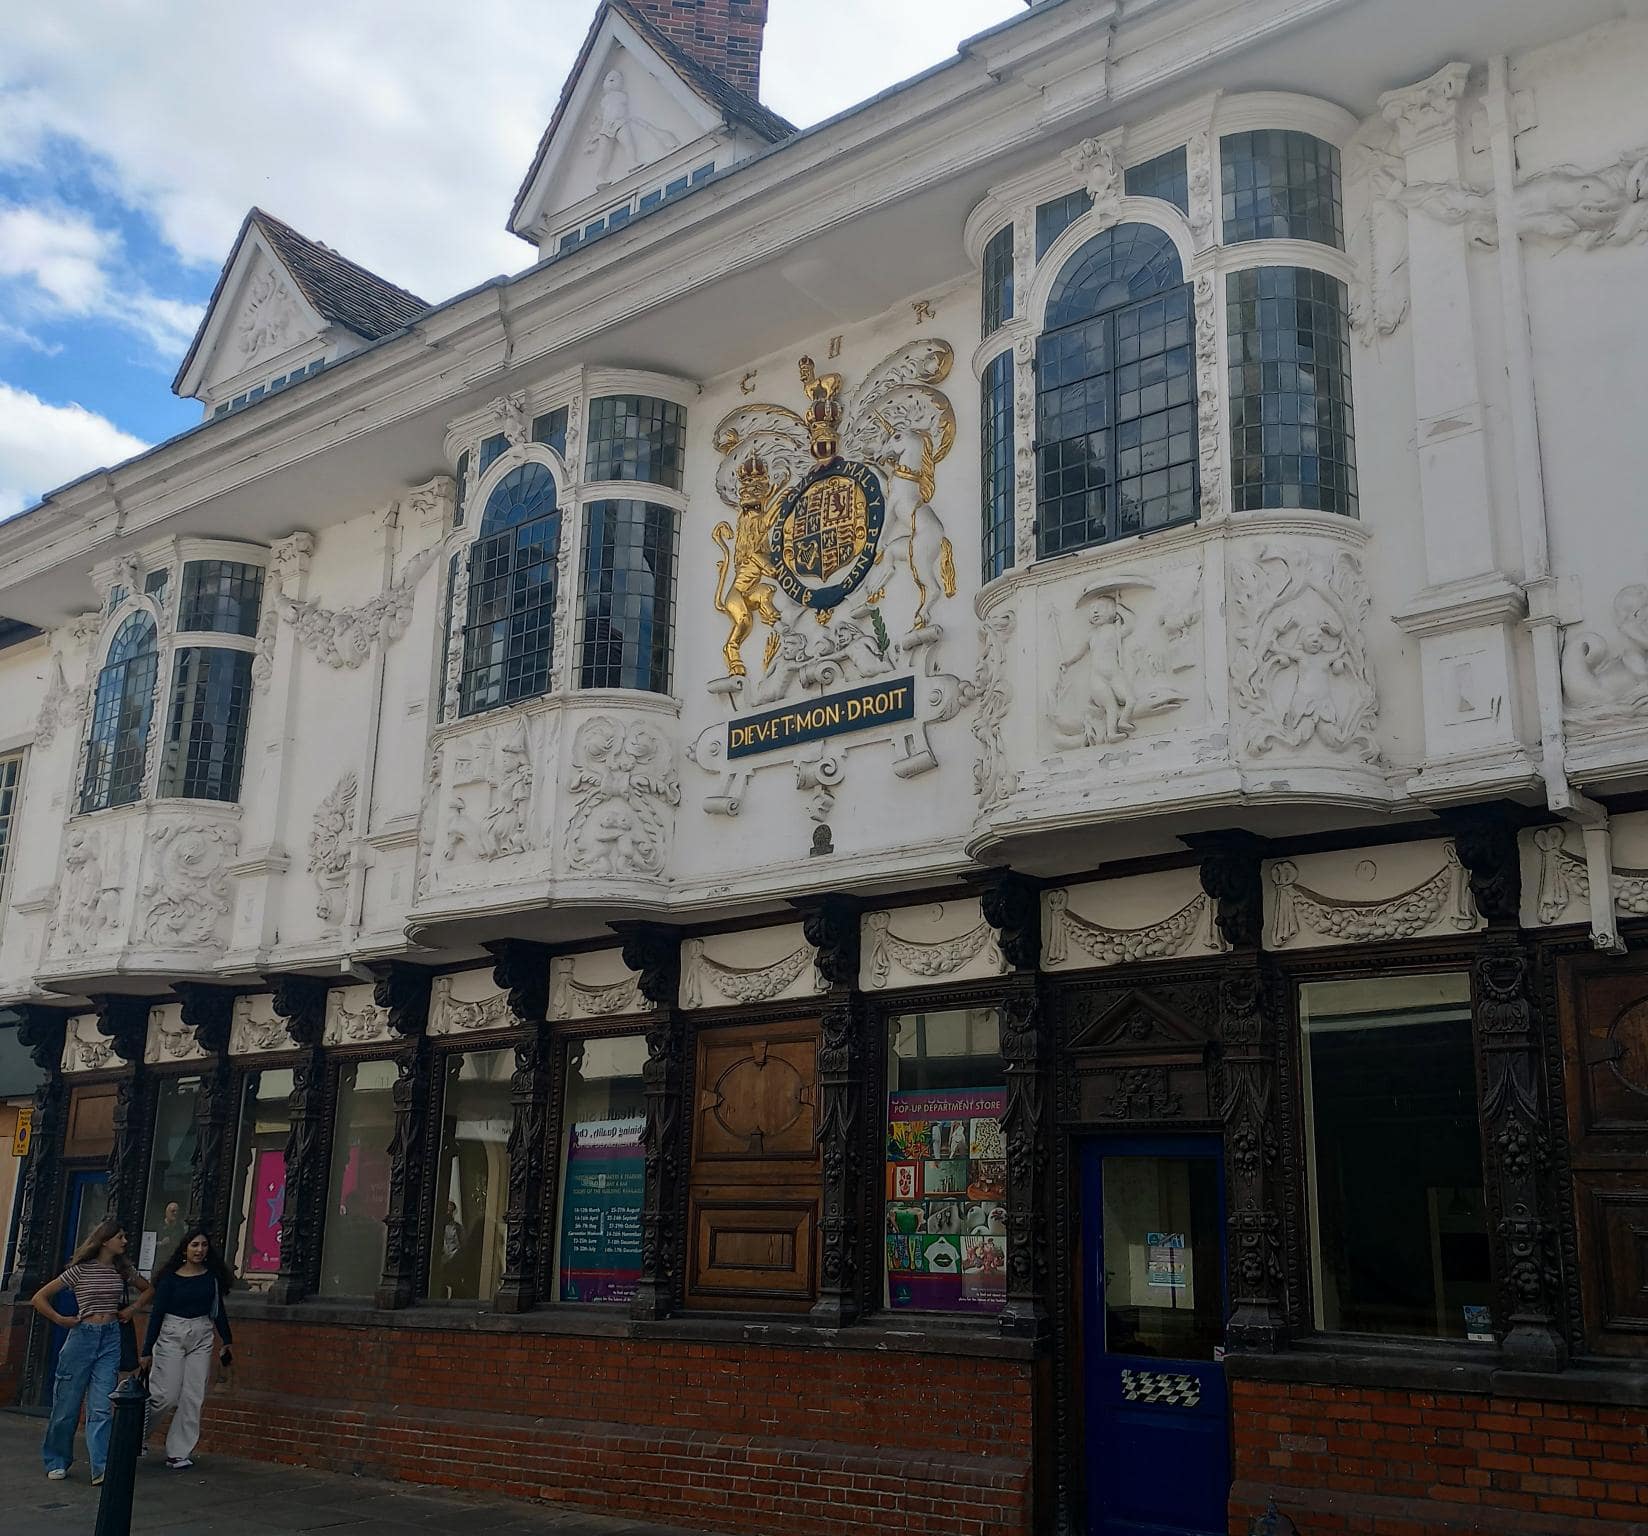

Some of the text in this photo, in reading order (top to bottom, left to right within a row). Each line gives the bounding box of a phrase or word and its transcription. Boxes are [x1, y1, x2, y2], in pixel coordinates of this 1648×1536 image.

[843, 462, 869, 489] MAL
[771, 513, 785, 553] SOIT
[842, 528, 879, 589] PENSE
[775, 560, 801, 598] HONI
[894, 1103, 922, 1114] POP-UP
[924, 1101, 973, 1113] DEPARTMENT
[975, 1100, 1001, 1110] STORE
